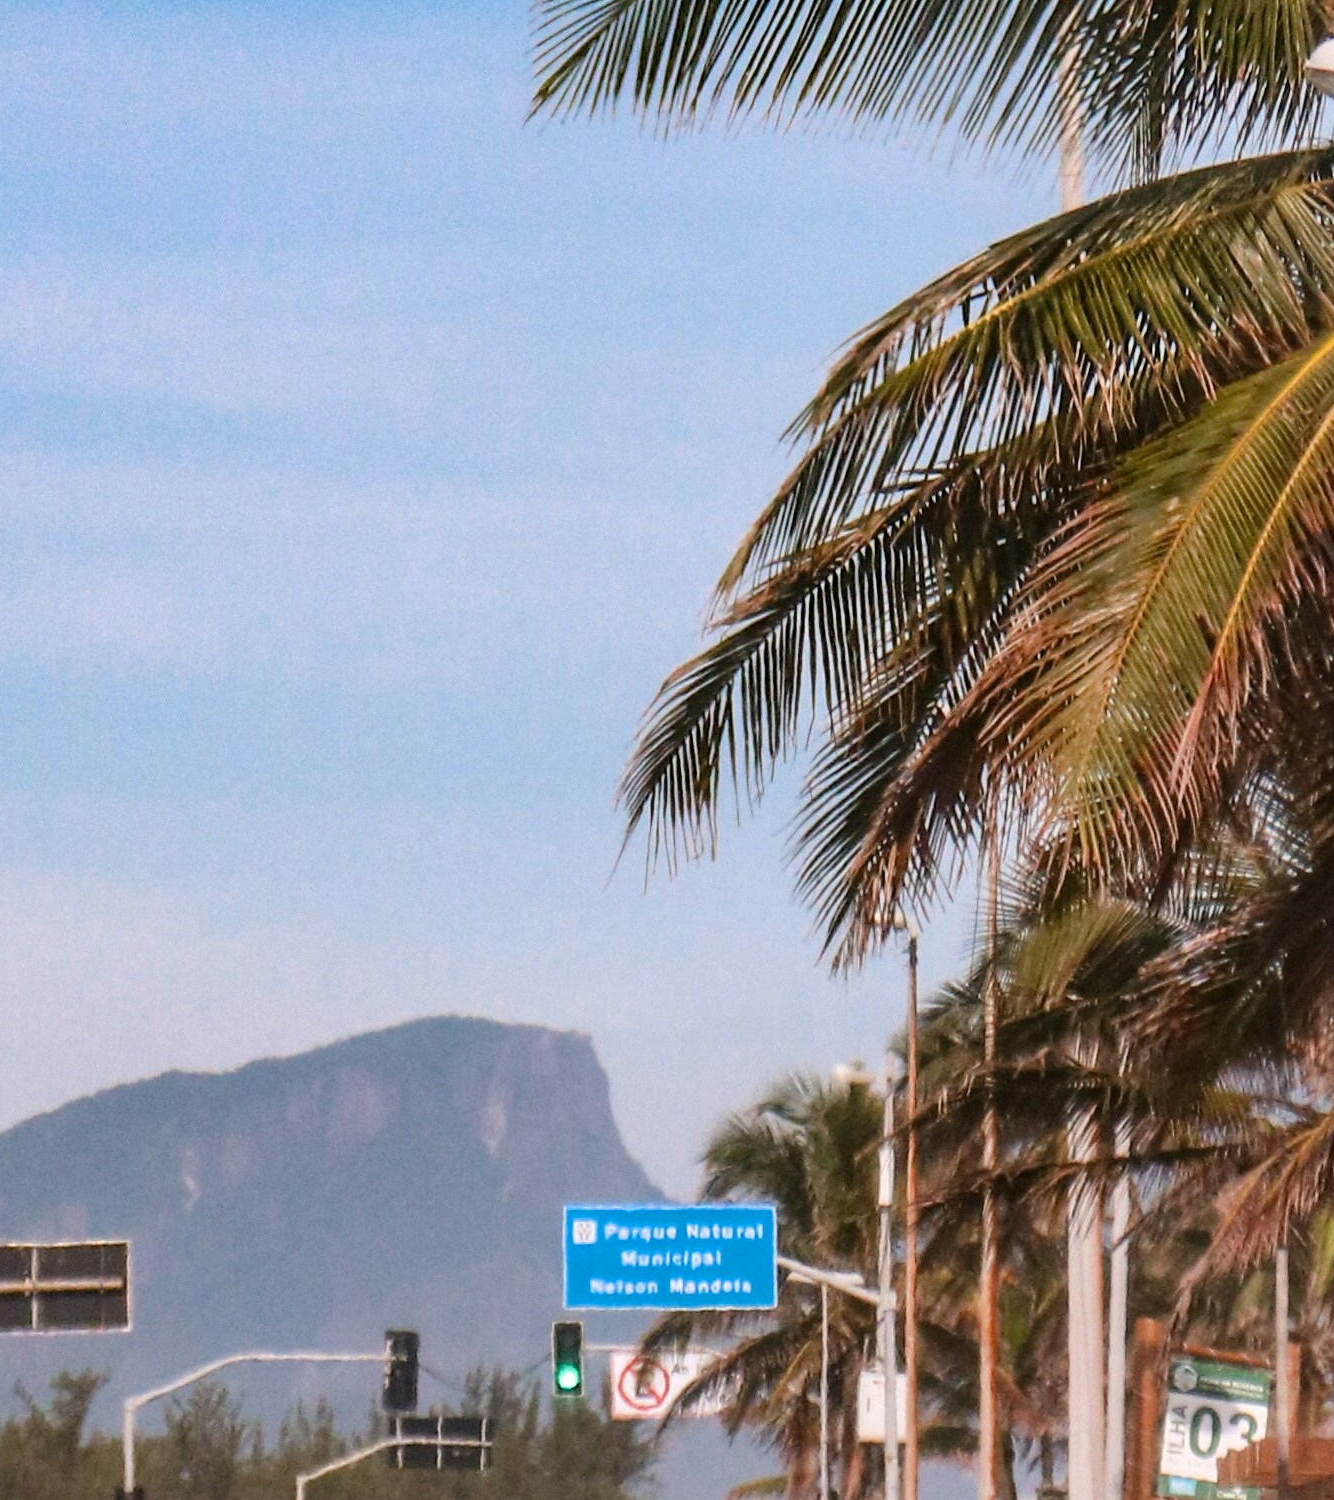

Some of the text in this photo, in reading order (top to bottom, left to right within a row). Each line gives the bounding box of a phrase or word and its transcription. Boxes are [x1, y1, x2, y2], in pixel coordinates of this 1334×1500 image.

[604, 1223, 764, 1243] Parque Natural
[621, 1250, 722, 1270] Municipal
[589, 1277, 752, 1295] Nelson Mandela
[1168, 1406, 1188, 1455] ILHA
